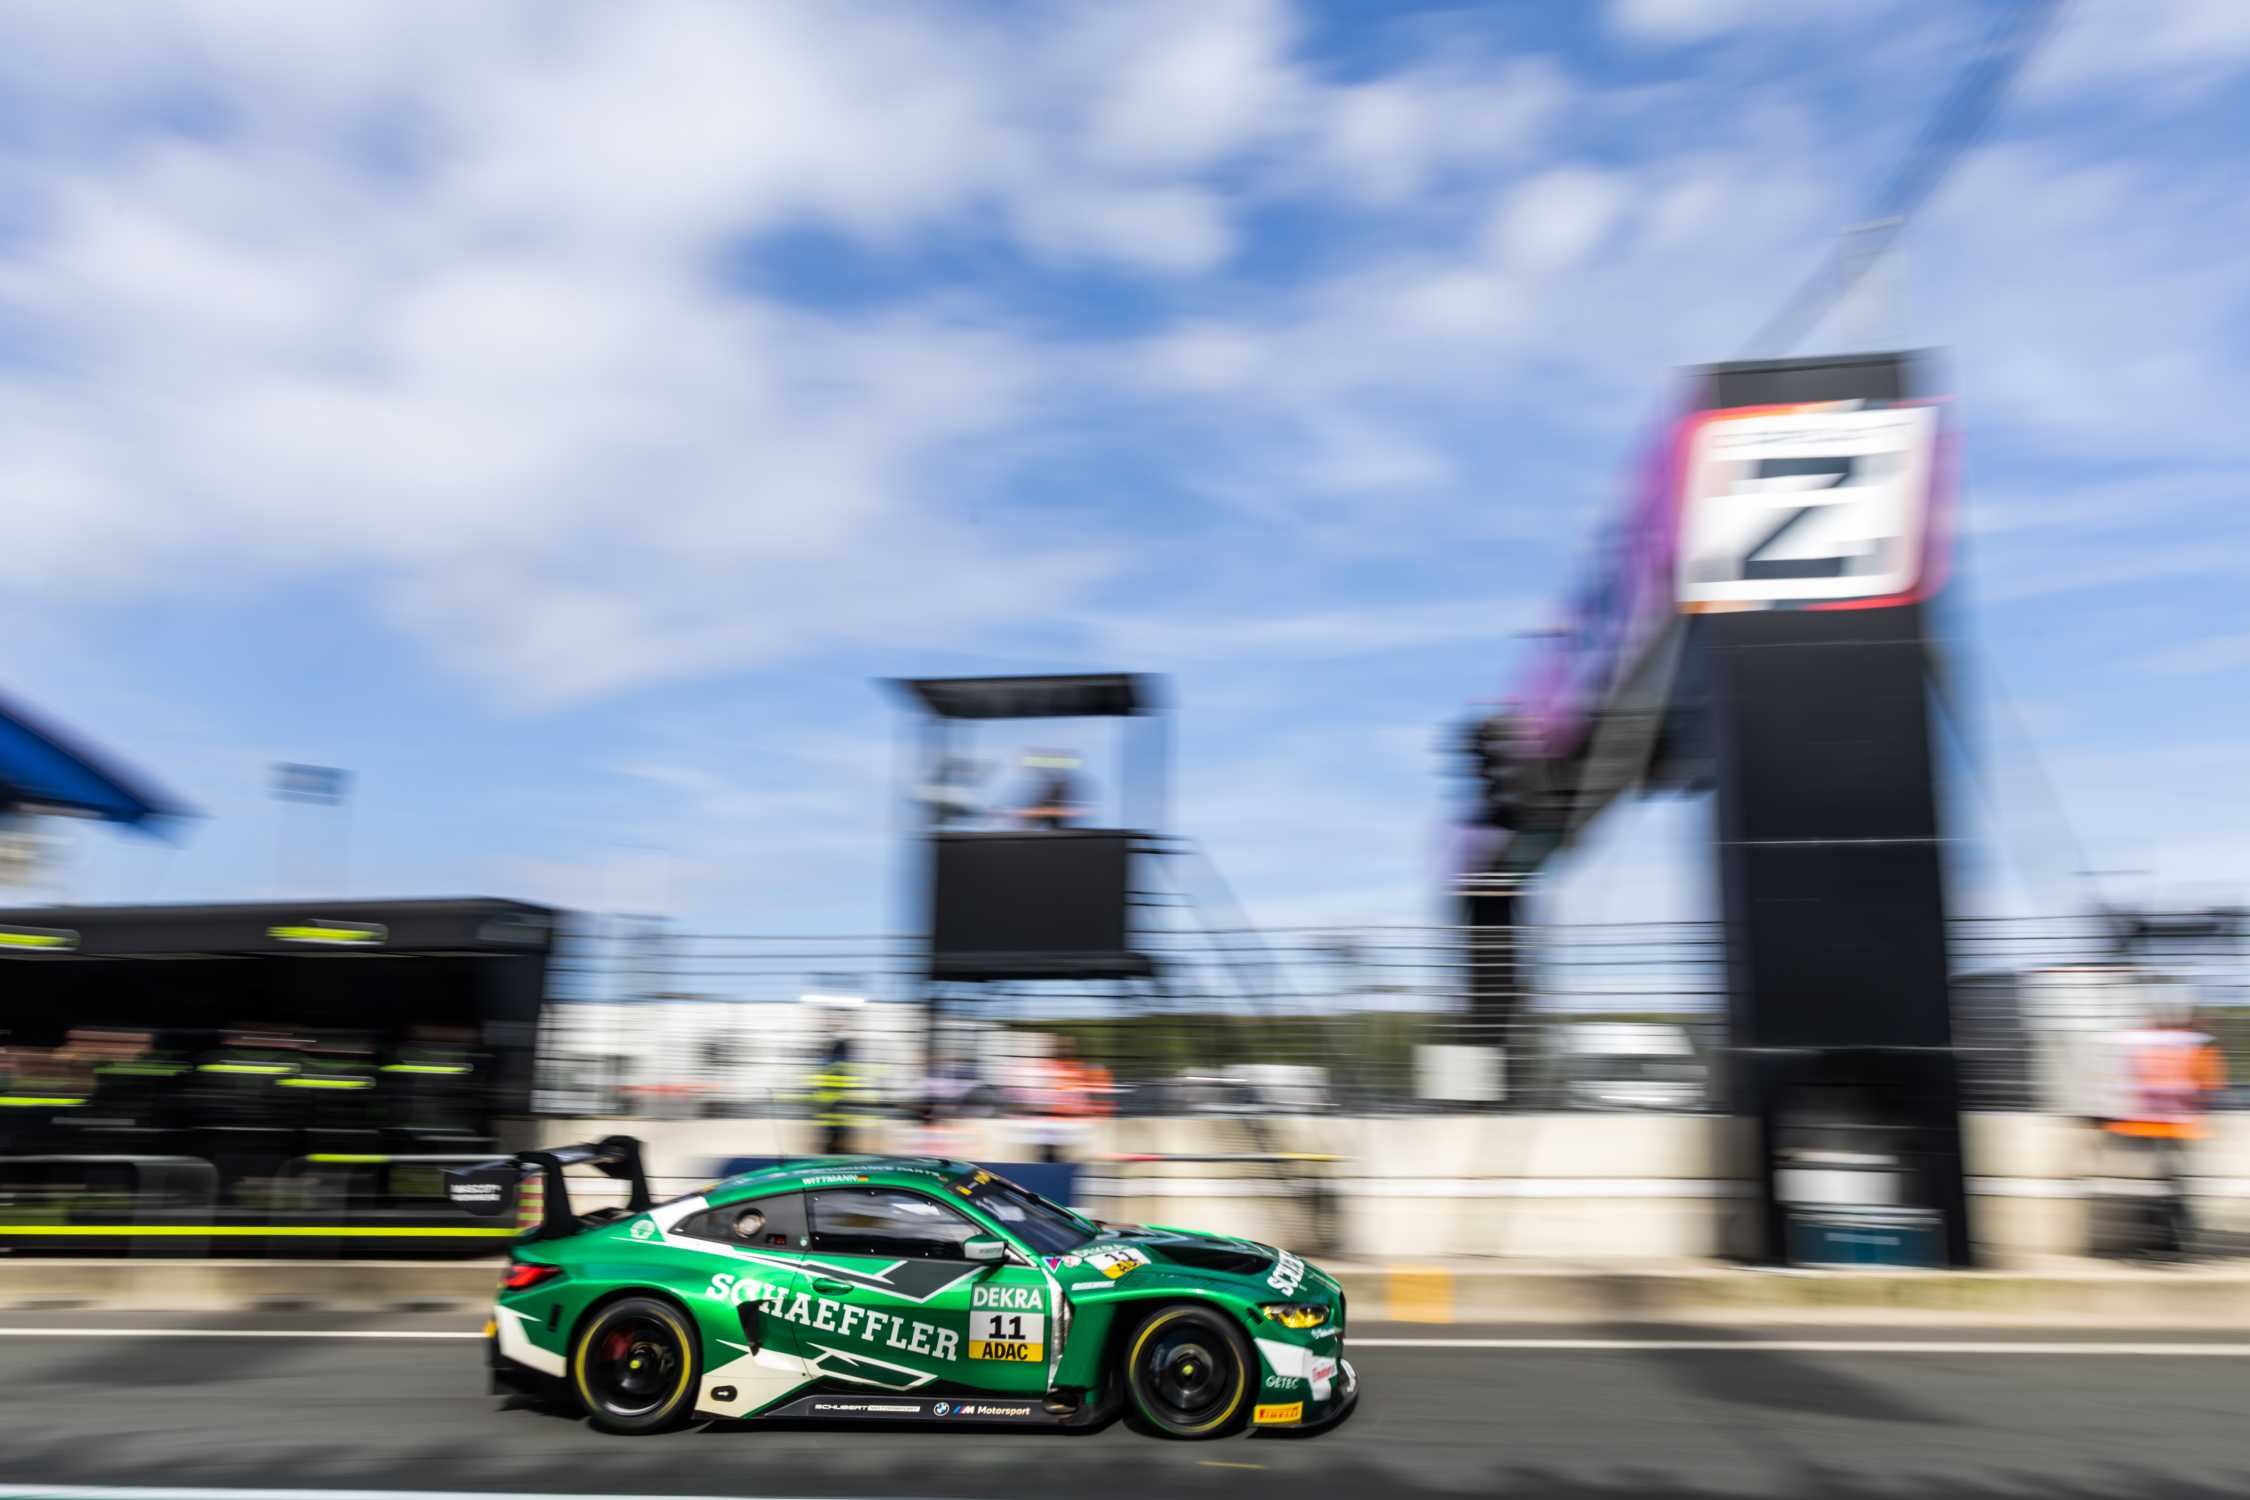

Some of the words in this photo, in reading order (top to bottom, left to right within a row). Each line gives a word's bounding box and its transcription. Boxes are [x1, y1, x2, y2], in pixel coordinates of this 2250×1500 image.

[801, 1174, 858, 1185] WITTMANN
[972, 1287, 1044, 1310] DEKRA
[704, 1272, 960, 1362] SCHAEFFLER
[988, 1314, 1027, 1341] 11
[982, 1342, 1029, 1361] ADAC
[977, 1406, 1032, 1417] Motorsport
